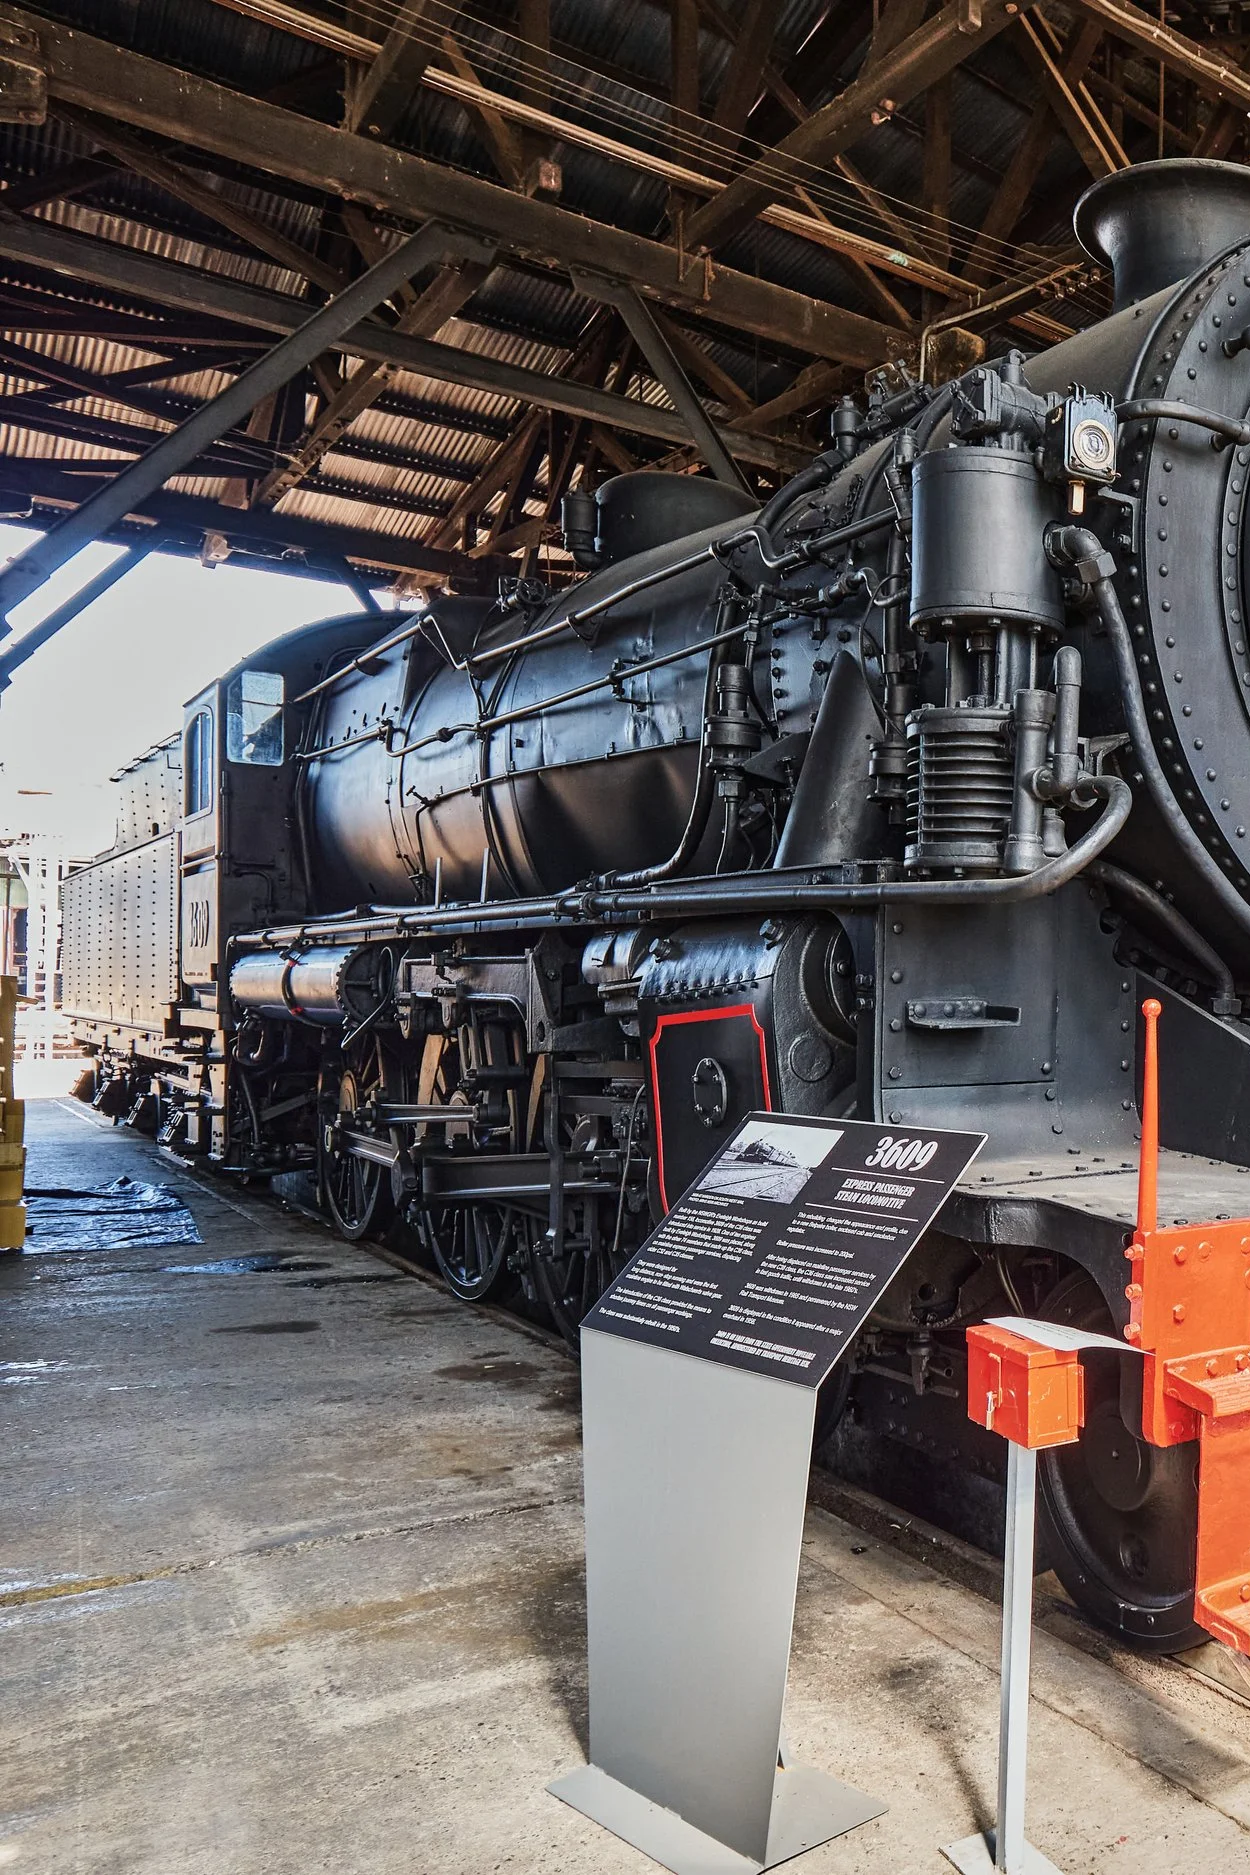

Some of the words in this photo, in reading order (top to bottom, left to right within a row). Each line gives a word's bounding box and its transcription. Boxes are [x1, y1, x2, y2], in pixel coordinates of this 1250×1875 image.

[864, 1136, 939, 1172] 3609
[841, 1178, 876, 1192] EXPRESS
[872, 1182, 916, 1197] PASSENGER
[834, 1190, 862, 1202] STEAM
[858, 1193, 907, 1210] LOCOMOTIVE
